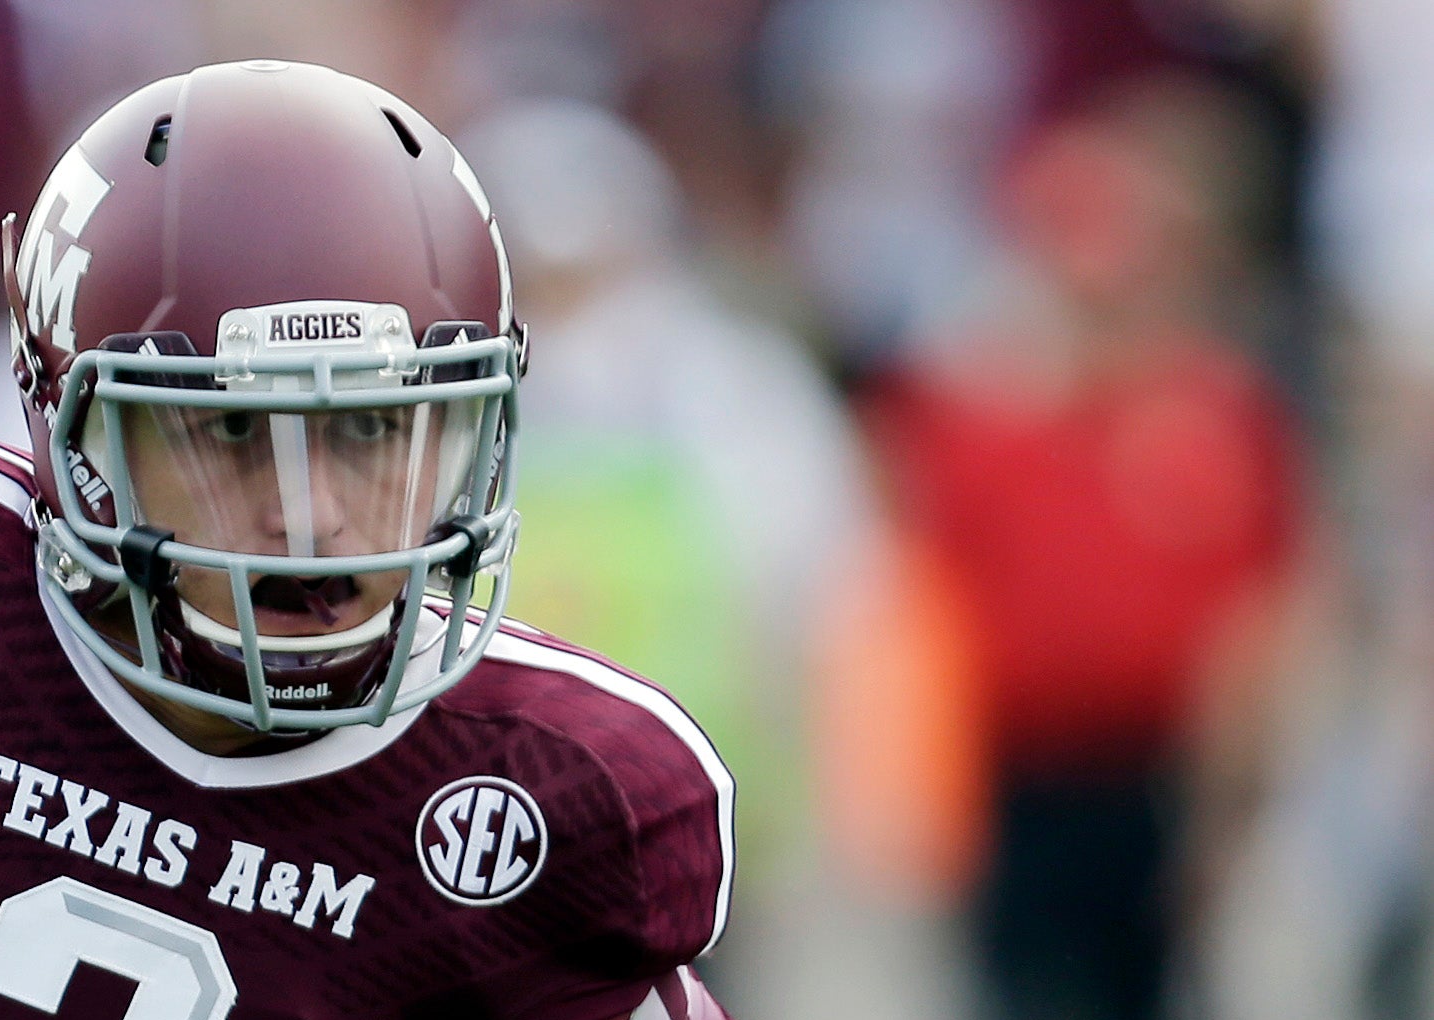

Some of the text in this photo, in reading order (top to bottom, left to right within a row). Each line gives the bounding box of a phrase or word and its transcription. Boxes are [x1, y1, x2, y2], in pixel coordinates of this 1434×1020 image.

[269, 312, 361, 341] AGGIES
[207, 839, 375, 939] A&M
[428, 786, 535, 895] SEC
